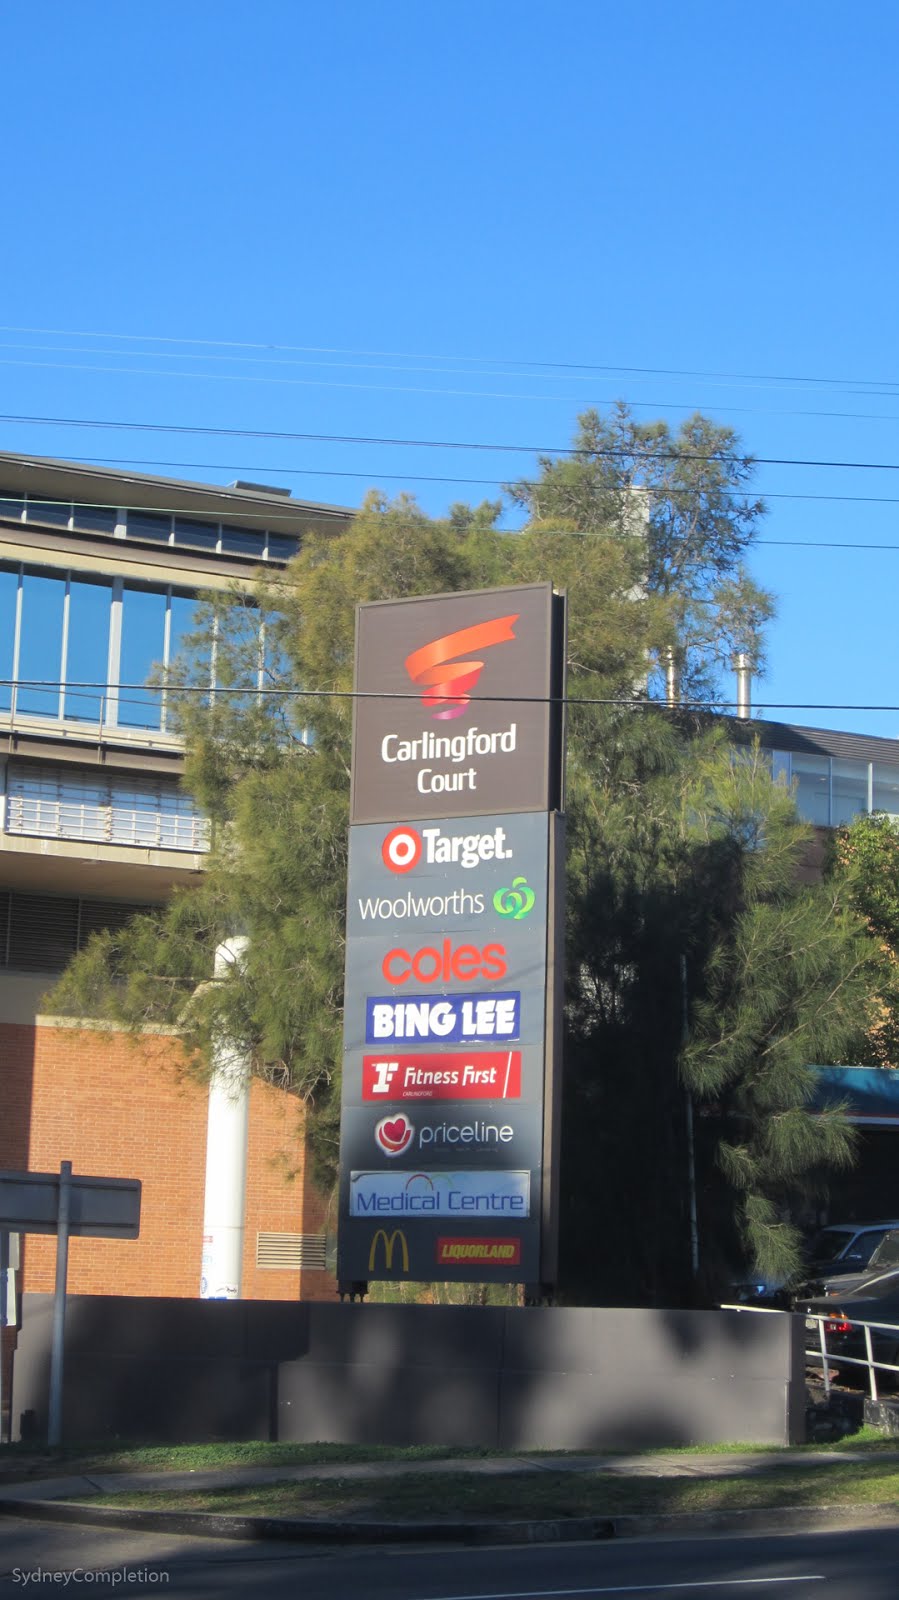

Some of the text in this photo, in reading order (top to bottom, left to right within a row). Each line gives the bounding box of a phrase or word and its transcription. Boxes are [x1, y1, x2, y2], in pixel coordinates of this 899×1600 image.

[381, 723, 517, 762] Carlingford
[417, 768, 477, 793] Court
[381, 938, 507, 985] coles
[372, 999, 516, 1038] BING LEE
[404, 1065, 497, 1087] Fitness First
[419, 1121, 514, 1148] priceline
[357, 1191, 524, 1211] Medical Centre
[441, 1244, 516, 1259] LIQUORLAND
